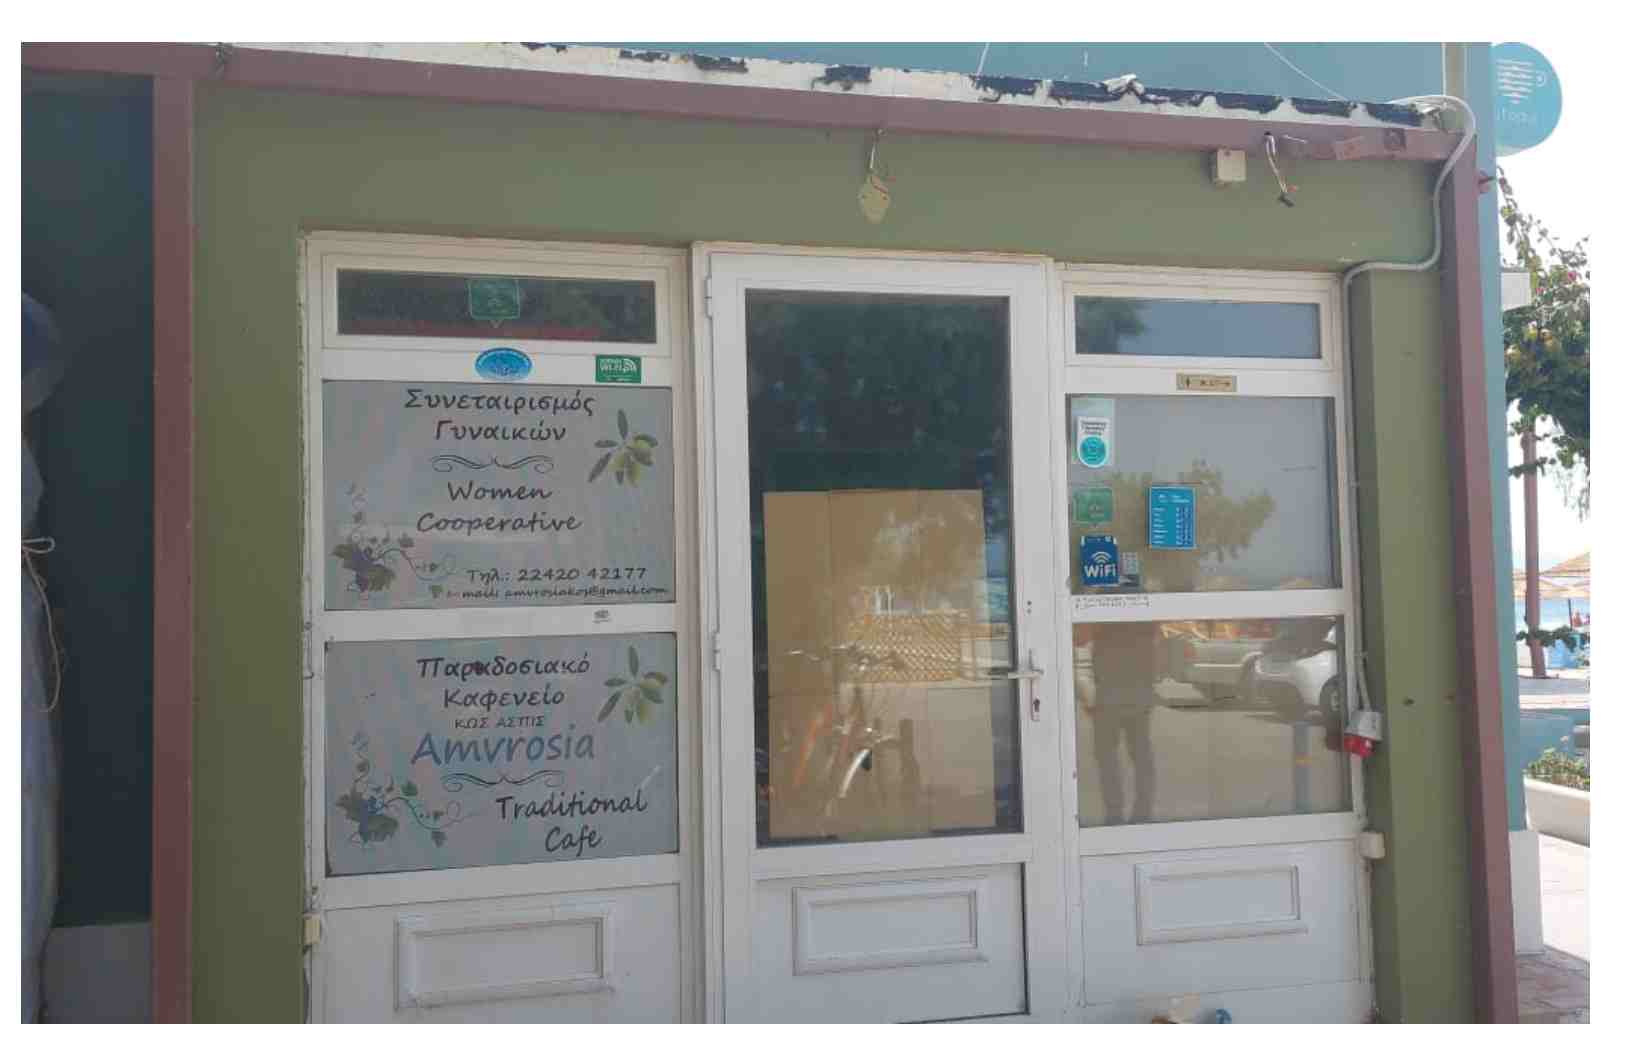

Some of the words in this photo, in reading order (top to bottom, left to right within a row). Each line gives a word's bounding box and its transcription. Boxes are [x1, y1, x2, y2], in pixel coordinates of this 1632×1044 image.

[405, 388, 596, 416] Συνεταιρισμός
[435, 420, 566, 441] Γυναικών
[447, 481, 553, 500] Women
[417, 512, 583, 536] Cooperative
[518, 568, 580, 581] 22420
[587, 567, 646, 580] 42177
[1084, 563, 1116, 578] WiFi
[417, 652, 590, 681] Παραδοσιακό
[443, 683, 564, 711] Καφενείο
[410, 724, 595, 766] Amvrosia
[496, 788, 648, 822] Traditional
